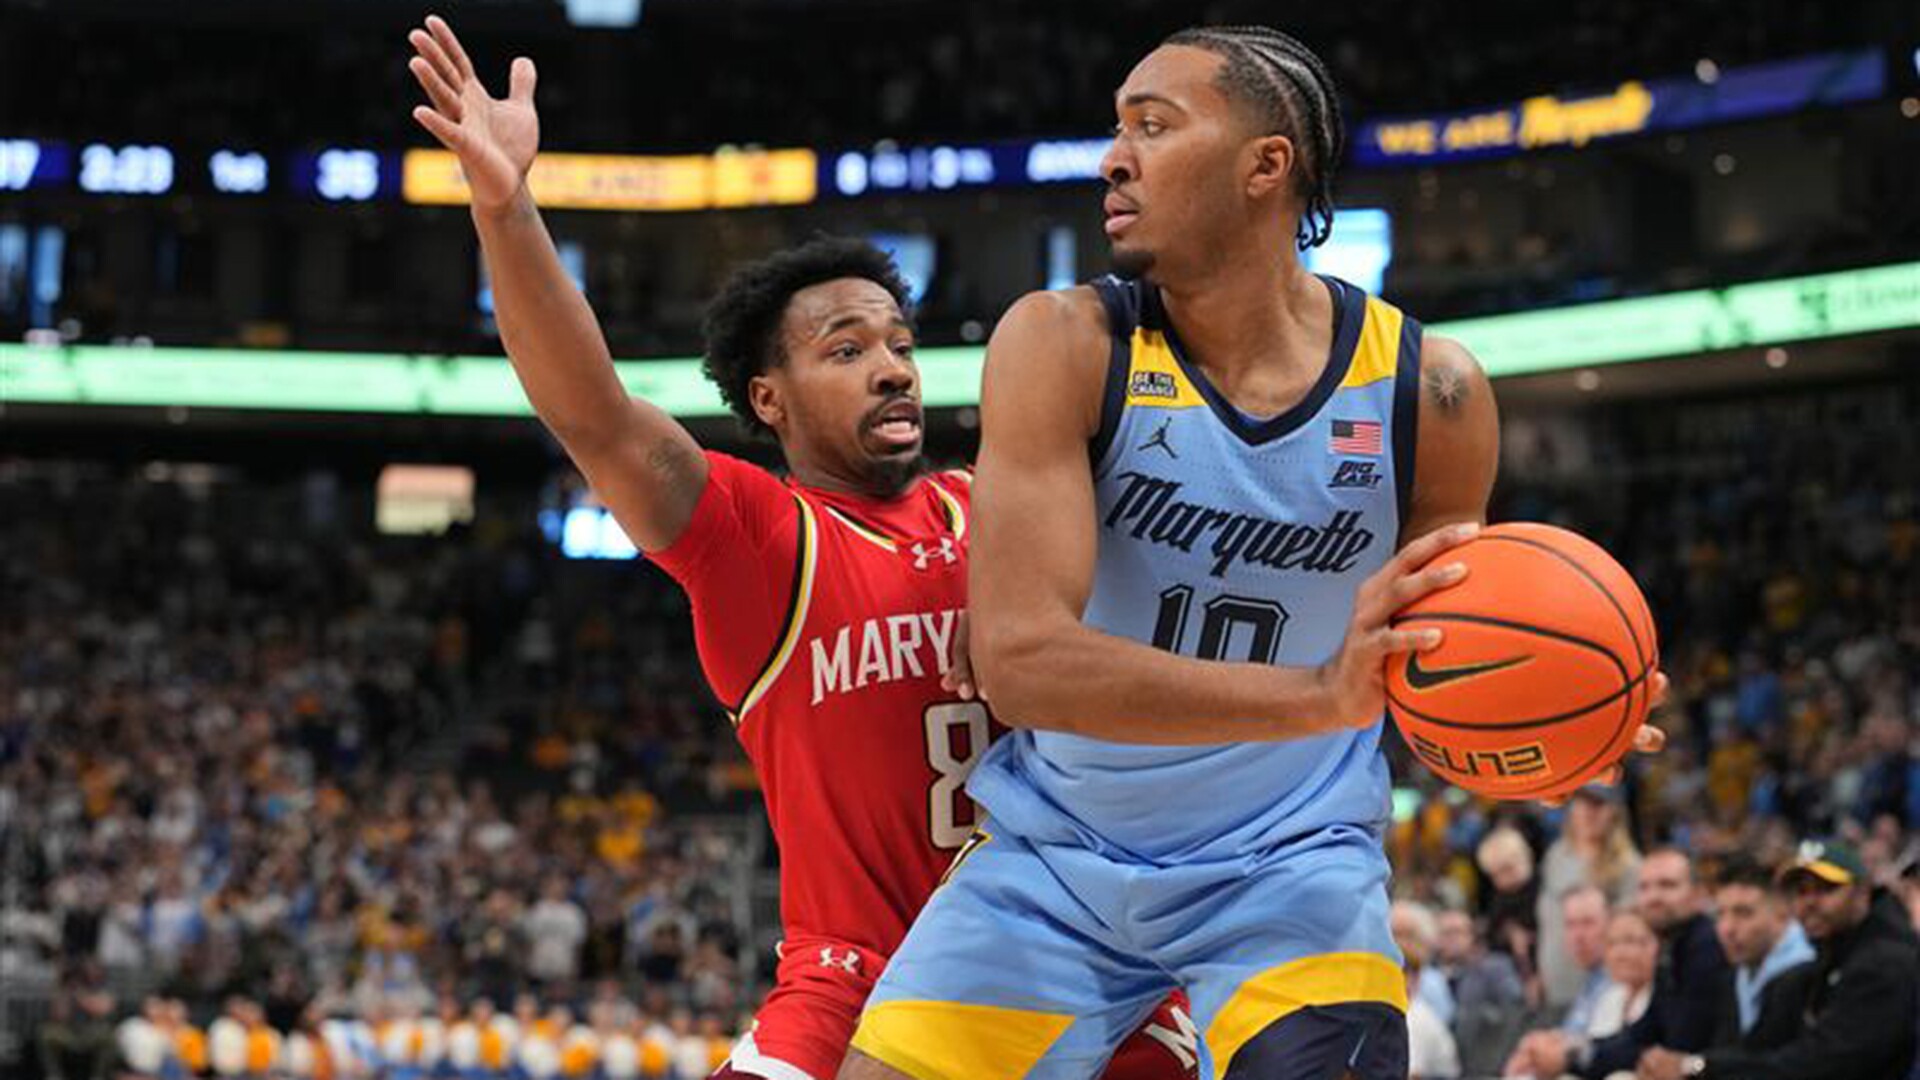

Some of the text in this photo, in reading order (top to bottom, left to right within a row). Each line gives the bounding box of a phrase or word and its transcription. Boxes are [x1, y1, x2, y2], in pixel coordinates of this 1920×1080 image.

[1105, 471, 1374, 578] Marquette
[810, 608, 969, 707] MARY
[922, 697, 991, 851] 8
